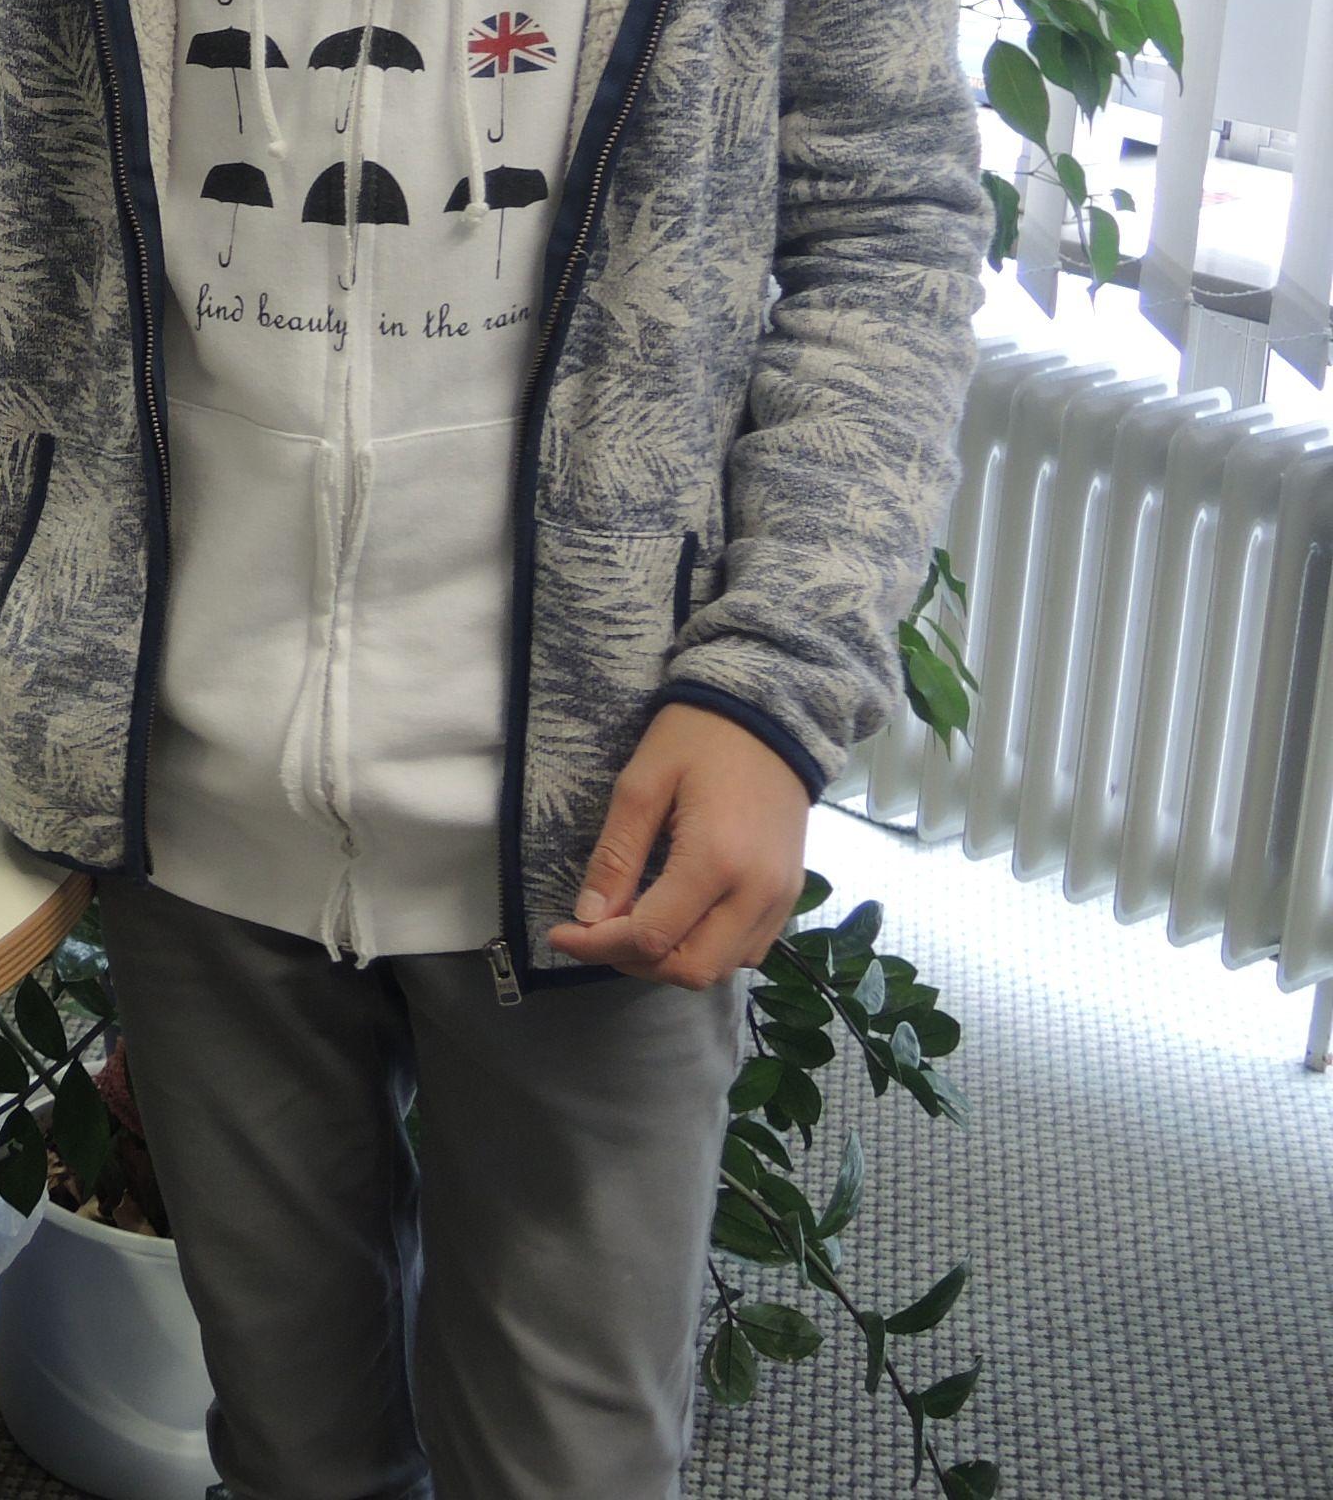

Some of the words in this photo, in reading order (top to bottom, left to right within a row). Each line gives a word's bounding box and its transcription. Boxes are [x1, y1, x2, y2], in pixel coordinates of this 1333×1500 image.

[195, 283, 244, 331] find
[257, 293, 349, 352] beauty
[379, 312, 408, 338] in
[422, 303, 471, 339] the
[483, 304, 531, 332] rain
